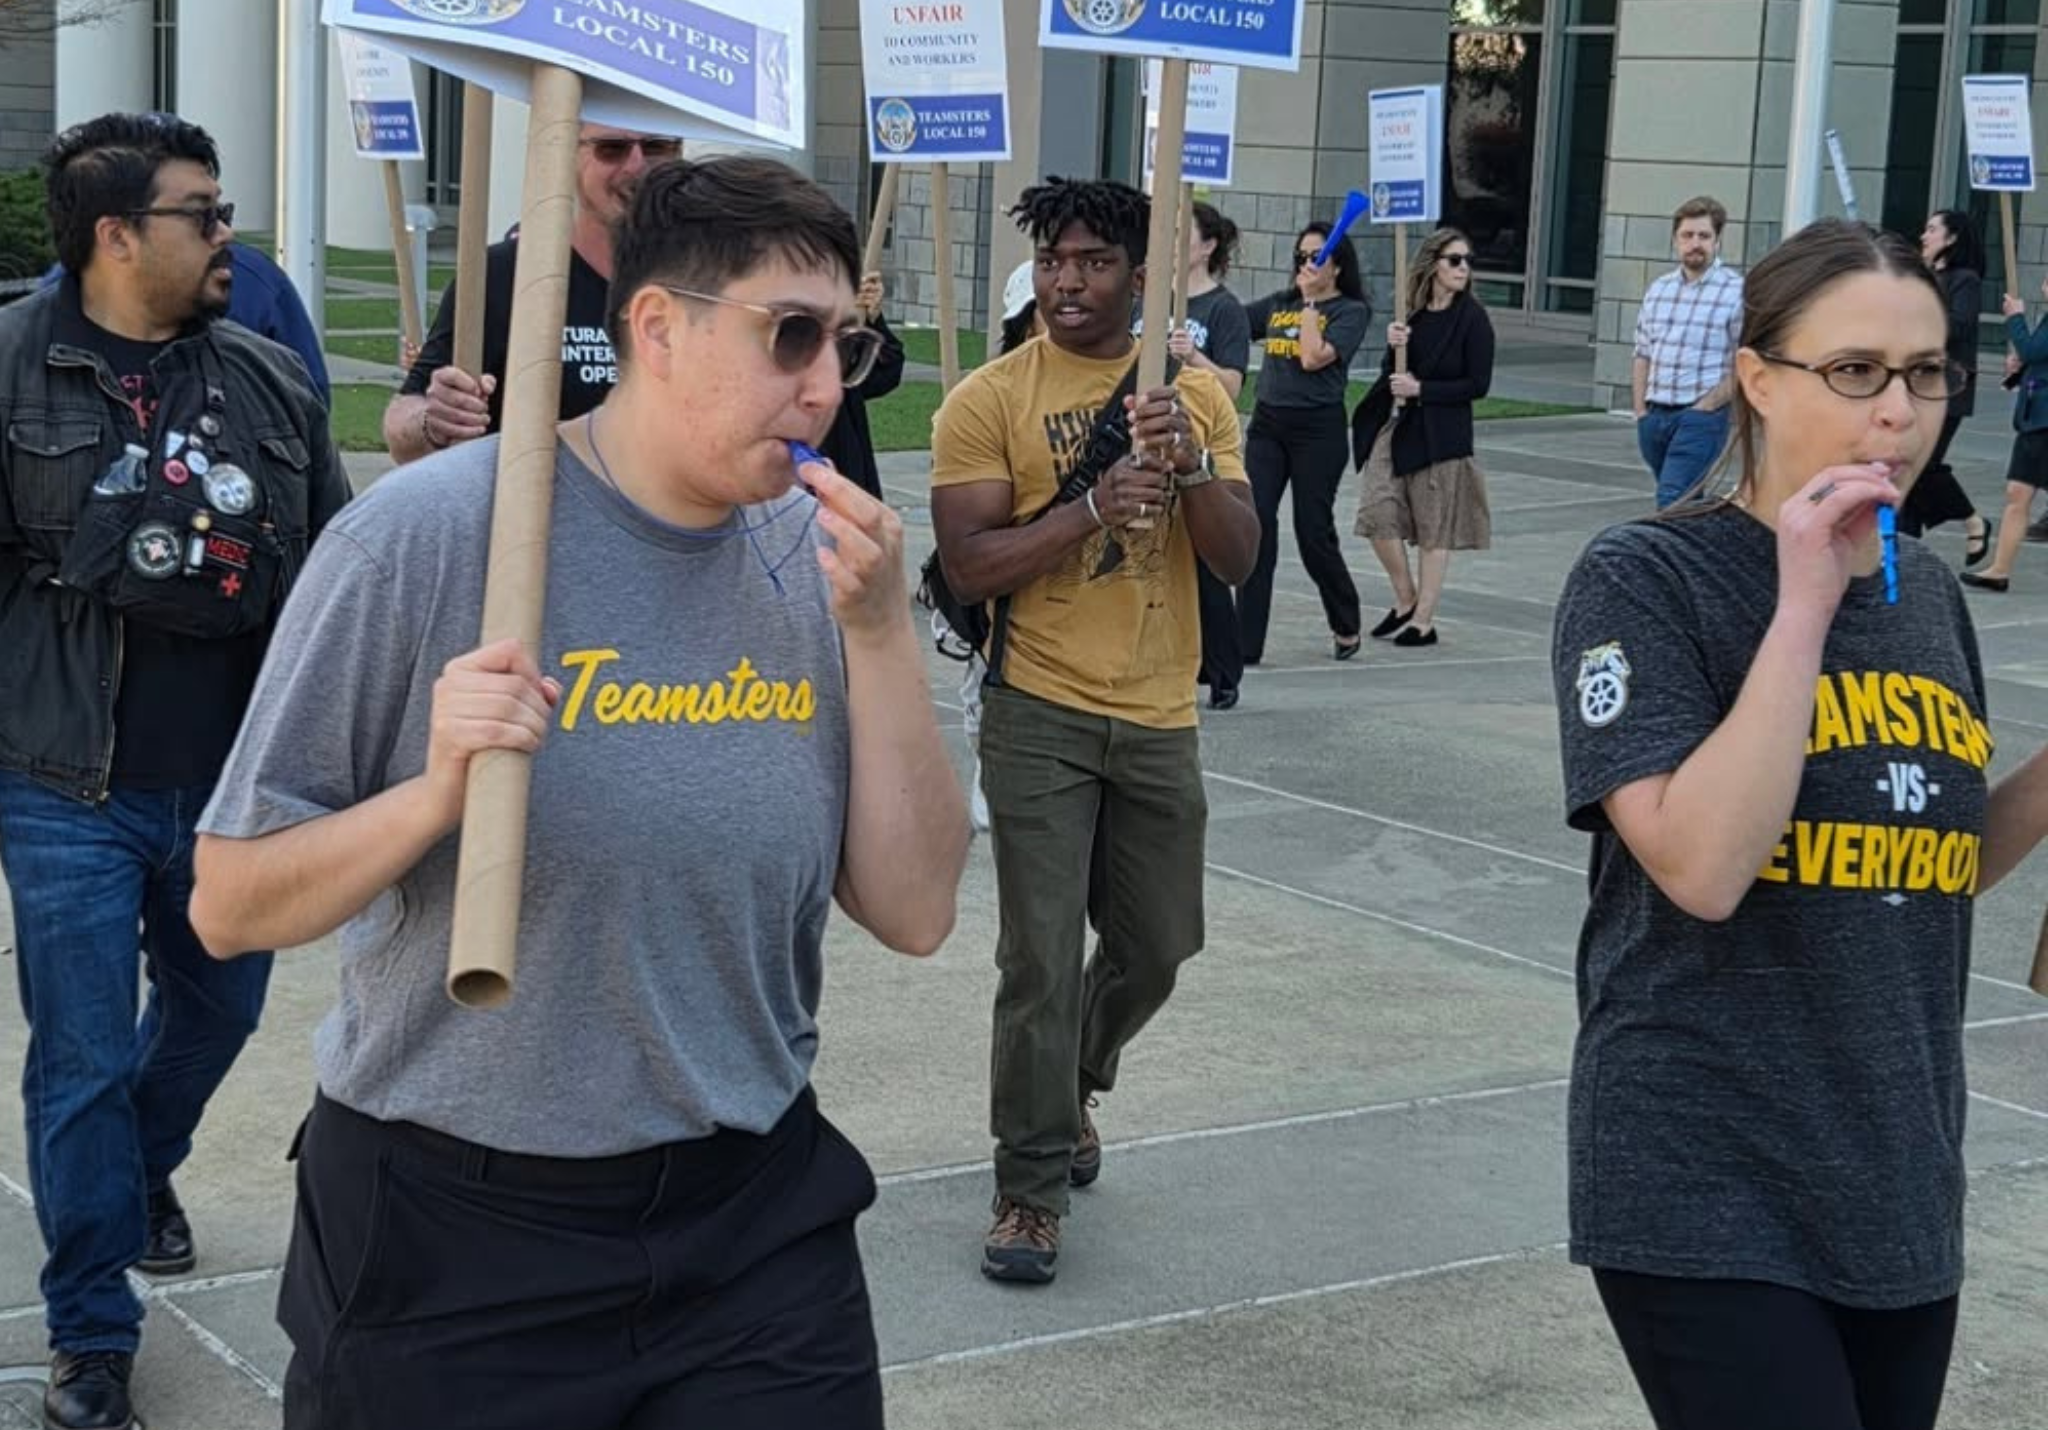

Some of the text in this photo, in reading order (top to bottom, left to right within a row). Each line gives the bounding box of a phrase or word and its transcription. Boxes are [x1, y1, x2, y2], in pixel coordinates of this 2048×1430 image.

[892, 4, 963, 25] UNFAIR
[1160, 1, 1265, 30] LOCAL 150
[566, 0, 750, 65] AMSTERS
[900, 33, 979, 47] COMMUNITY
[553, 6, 735, 87] LOCAL 150
[913, 52, 978, 65] WORKERS
[917, 109, 992, 124] TEAMSTERS
[924, 126, 988, 140] LOCAL 150
[580, 365, 619, 383] OPE
[560, 649, 817, 732] Teamsters
